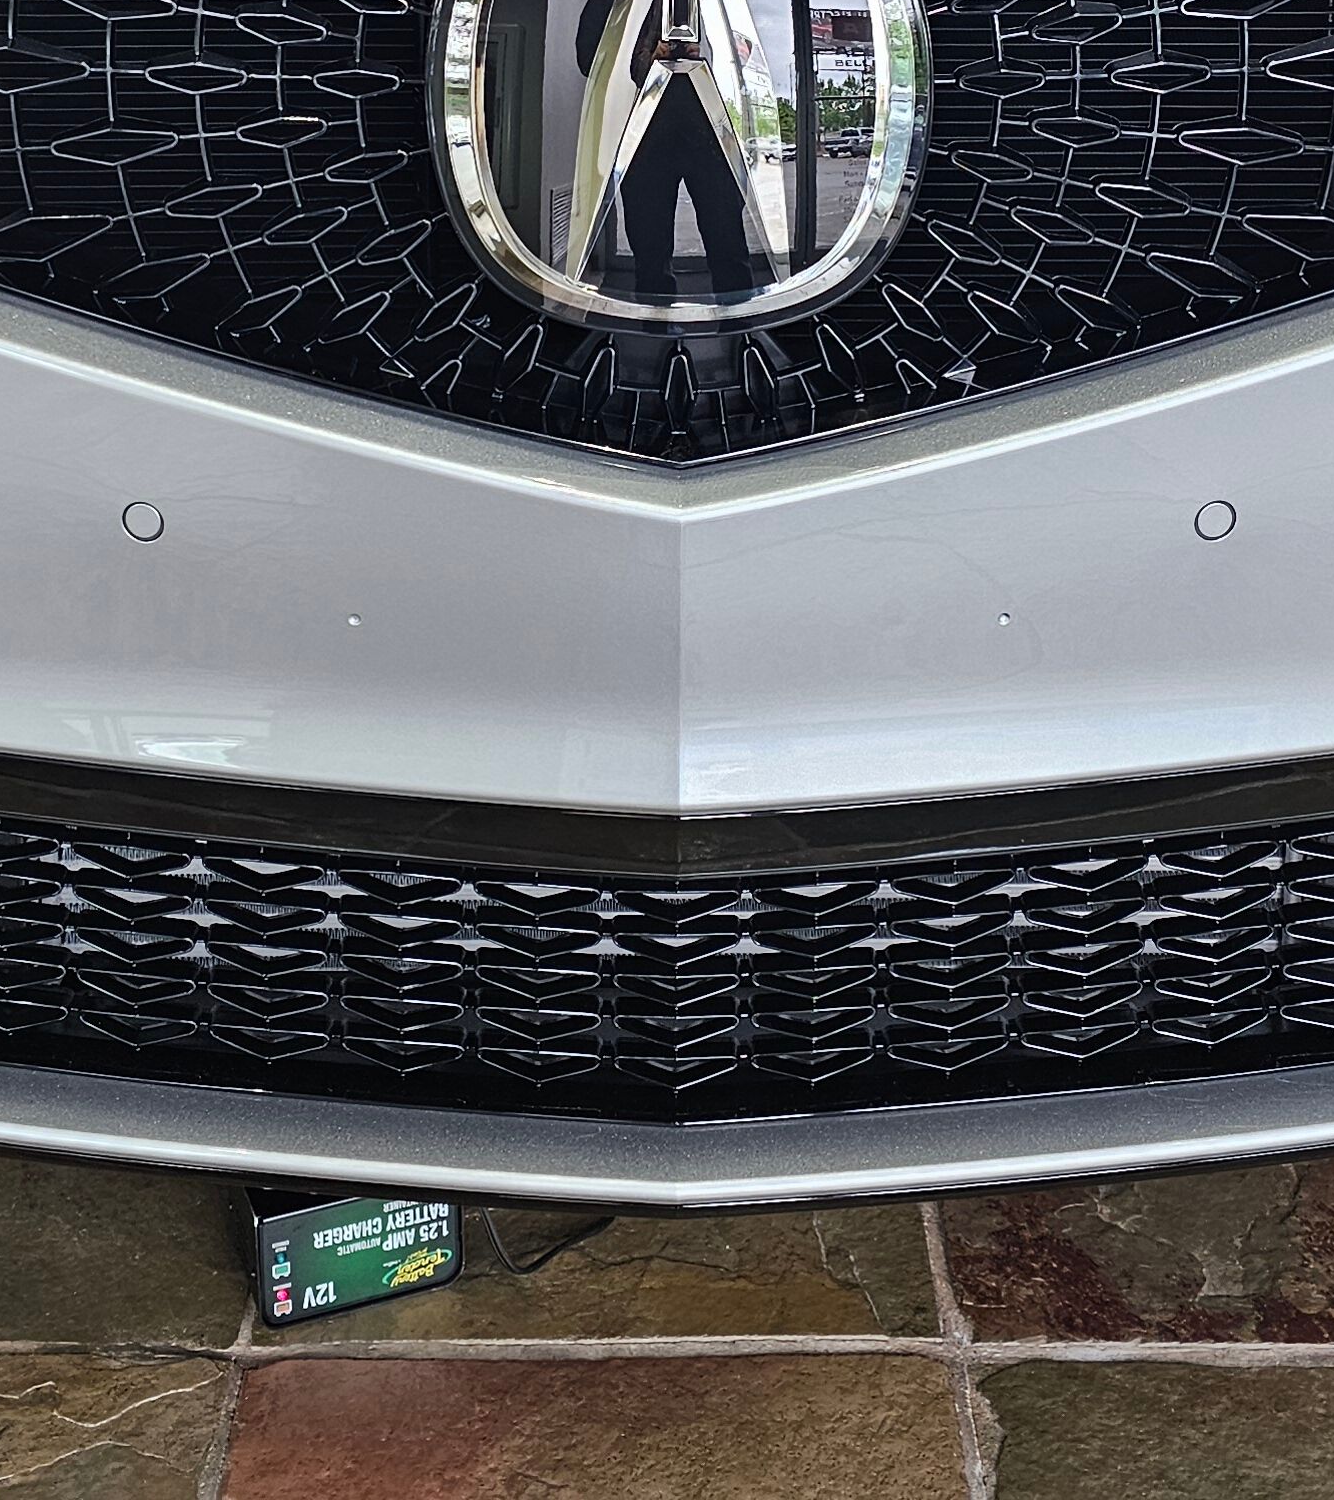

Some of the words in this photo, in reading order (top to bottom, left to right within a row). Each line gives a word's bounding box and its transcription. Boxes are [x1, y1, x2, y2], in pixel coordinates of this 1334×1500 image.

[386, 1203, 449, 1232] BATTERY
[419, 1219, 449, 1242] 1.25
[313, 1217, 382, 1249] CHARGER
[382, 1227, 415, 1251] AMP
[337, 1237, 381, 1257] AUTOMATIC
[398, 1247, 446, 1275] Tender
[390, 1263, 435, 1288] Battery
[303, 1280, 337, 1310] 12V
